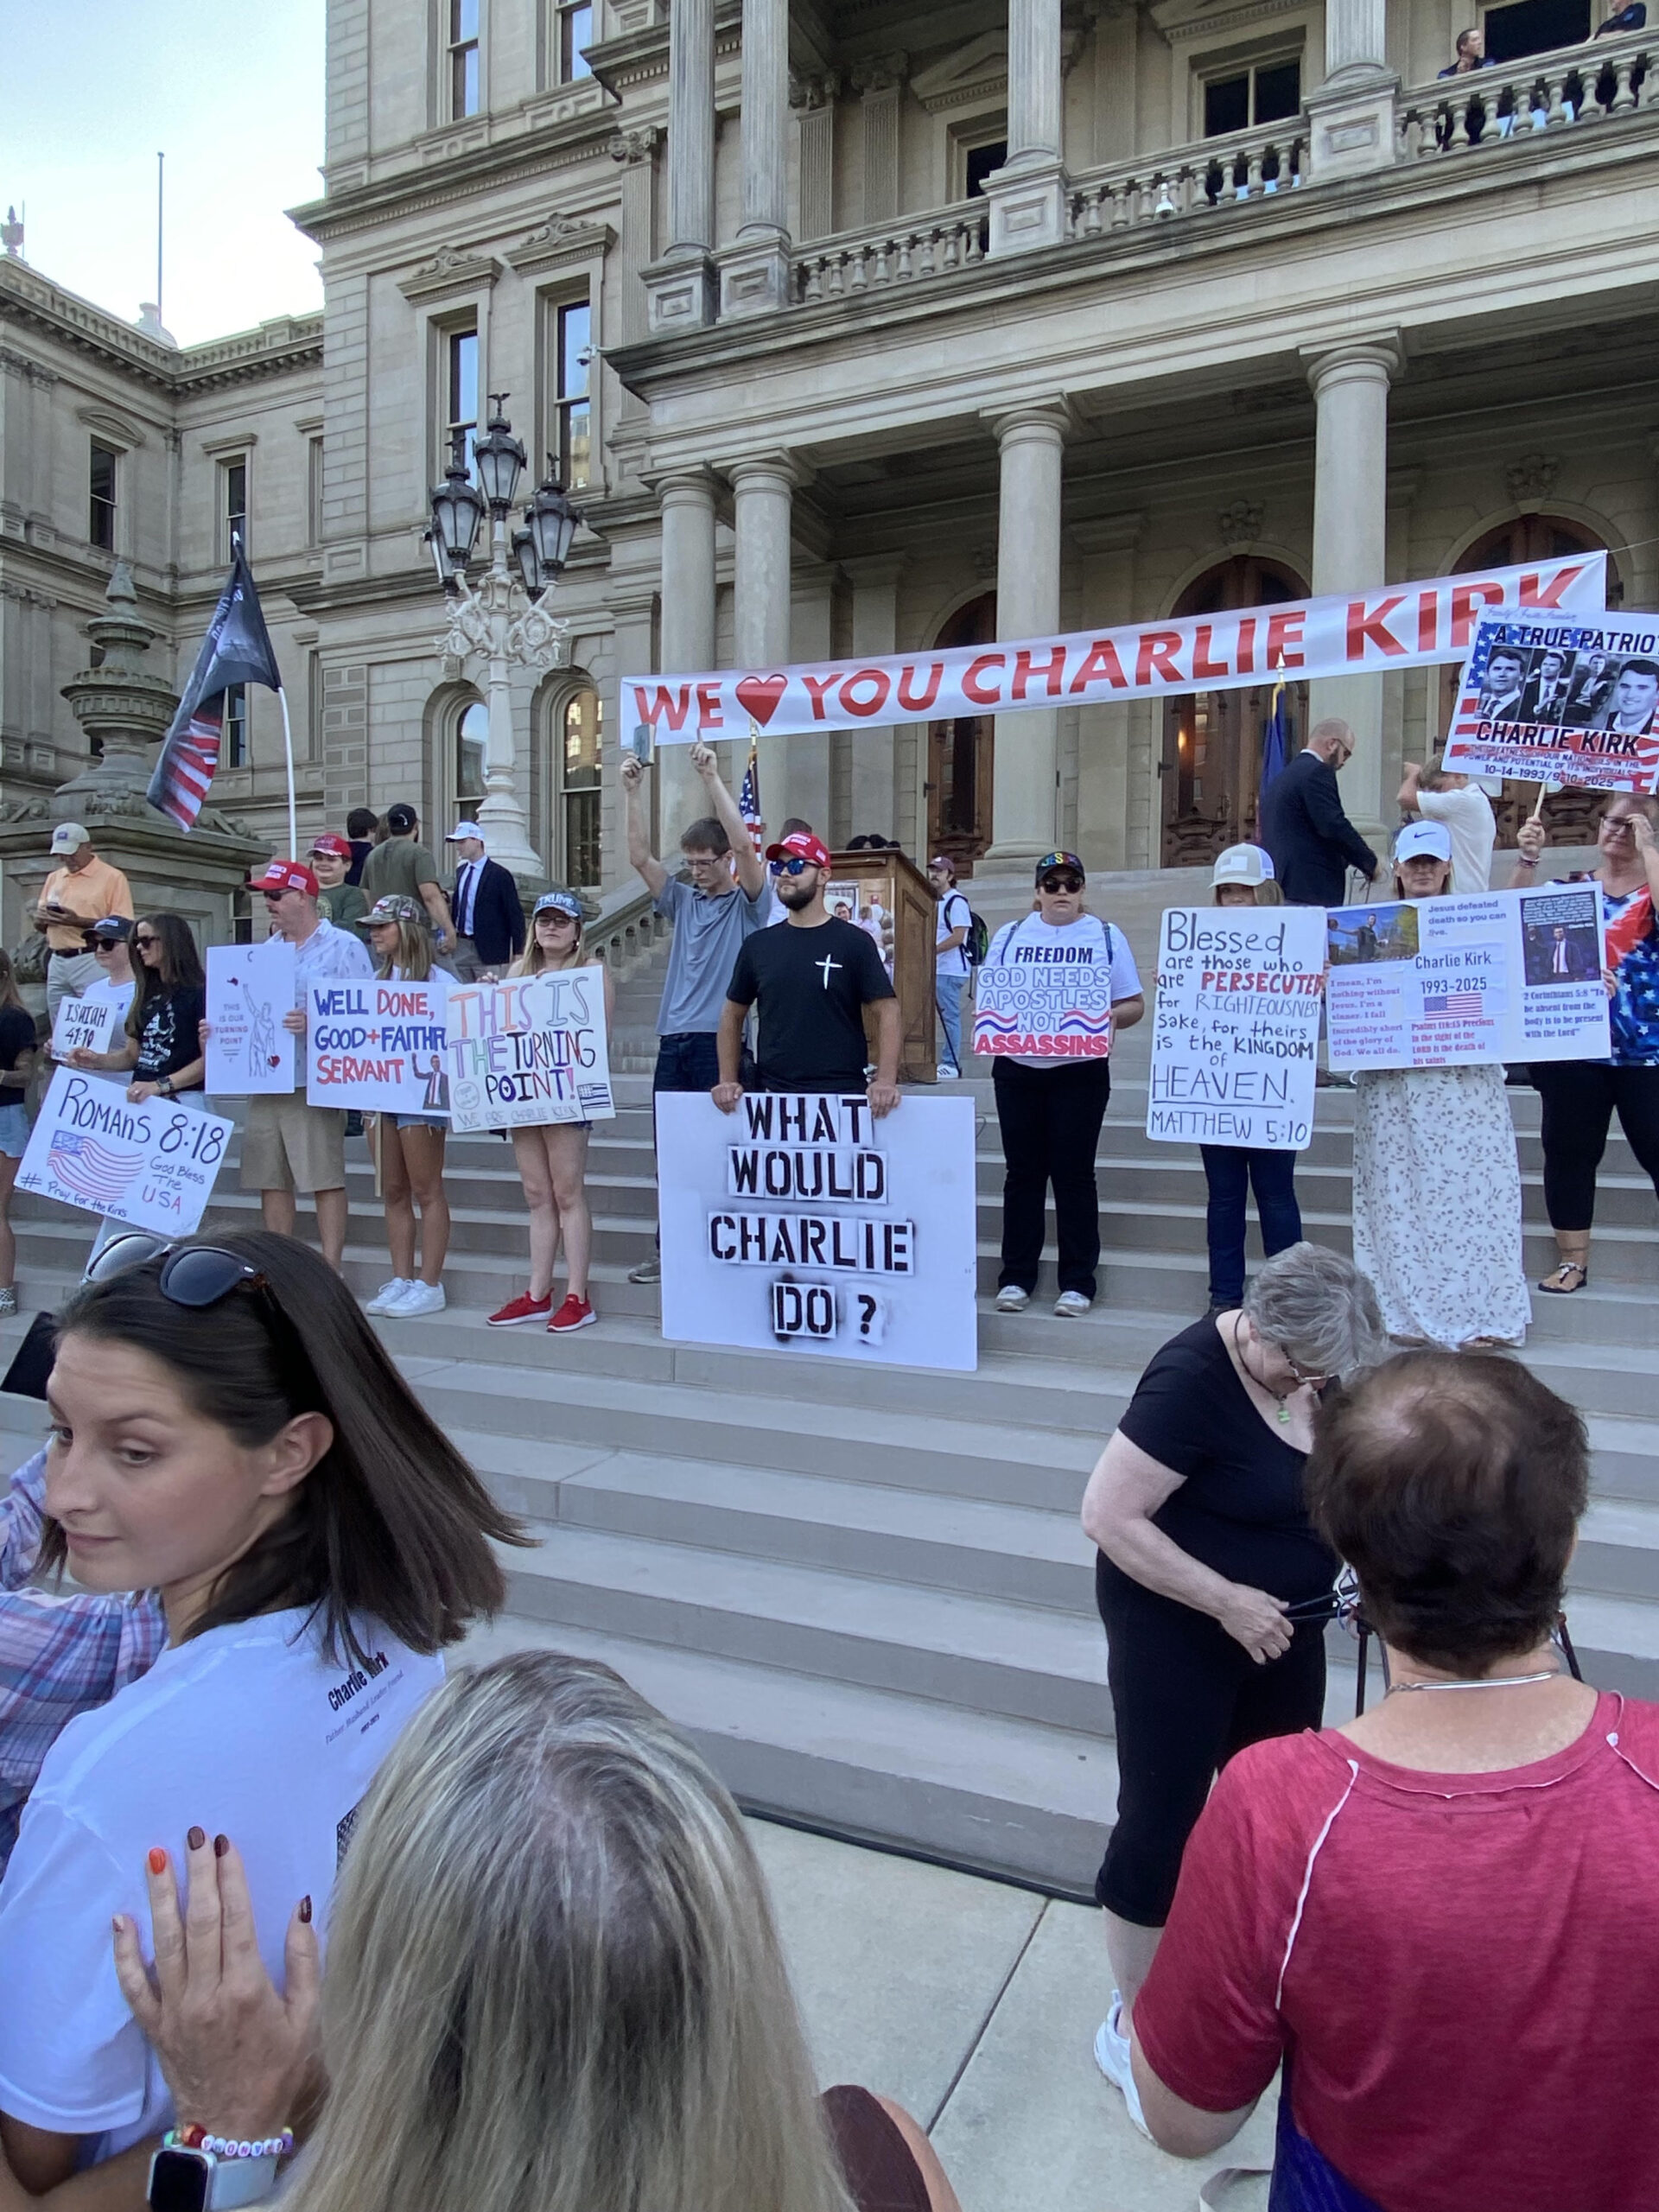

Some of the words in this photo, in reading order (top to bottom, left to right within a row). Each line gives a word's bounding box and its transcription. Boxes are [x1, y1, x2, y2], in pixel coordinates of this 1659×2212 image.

[634, 683, 723, 731] WE
[801, 663, 944, 721] YOU
[961, 611, 1306, 704] CHARLIE
[1345, 566, 1586, 661] KIRK
[1494, 625, 1506, 644] A
[1518, 626, 1572, 647] TRUE
[1579, 631, 1659, 653] PATRIO
[1476, 721, 1574, 749] CHARLIE
[1580, 731, 1640, 756] KIRK
[538, 893, 575, 907] TRUMP
[1428, 905, 1455, 913] Jesus
[1457, 899, 1498, 912] defeated
[1470, 914, 1487, 923] you
[1167, 911, 1286, 956] Blessed
[1014, 947, 1093, 964] FREEDOM
[1166, 956, 1194, 969] are
[1201, 954, 1251, 970] those
[1263, 957, 1303, 972] who
[1415, 954, 1460, 969] Charlie
[1465, 950, 1492, 966] Kirk
[978, 966, 1026, 988] GOD
[1033, 966, 1111, 988] NEEDS
[1157, 973, 1185, 988] are
[1201, 971, 1323, 997] PERSECUTED
[1421, 977, 1487, 995] 1993-2025
[314, 989, 369, 1016] WELL
[377, 988, 435, 1020] DONE,
[448, 983, 533, 1038] THIS
[545, 976, 589, 1027] IS
[979, 988, 1107, 1011] APOSTLES
[1158, 993, 1179, 1009] for
[1530, 990, 1573, 1001] Corinthians
[65, 1004, 108, 1028] ISAIAH
[1016, 1012, 1065, 1033] NOT
[1574, 1014, 1603, 1024] present
[65, 1027, 95, 1048] 41:10
[1211, 1020, 1239, 1035] for
[1250, 1020, 1306, 1039] theirs
[1359, 1037, 1382, 1046] glory
[449, 1035, 507, 1078] THE
[506, 1029, 595, 1070] TURNING
[975, 1033, 1109, 1055] ASSASSINS
[1156, 1036, 1173, 1051] is
[1190, 1035, 1222, 1052] the
[1234, 1037, 1314, 1060] KINGDOM
[316, 1055, 404, 1084] SERVANT
[1210, 1052, 1228, 1067] of
[485, 1067, 575, 1105] POINT!
[1152, 1064, 1294, 1103] HEAVEN.
[745, 1096, 868, 1143] WHAT
[1151, 1110, 1252, 1139] MATTHEW
[1266, 1120, 1307, 1142] 5:10
[159, 1114, 224, 1165] 8:18
[149, 1155, 175, 1174] God
[177, 1166, 206, 1185] Bless
[732, 1148, 885, 1199] WOULD
[48, 1181, 71, 1201] Pray
[142, 1185, 181, 1216] USA
[710, 1215, 909, 1272] CHARLIE
[776, 1285, 833, 1335] DO
[328, 1670, 367, 1712] Charlie
